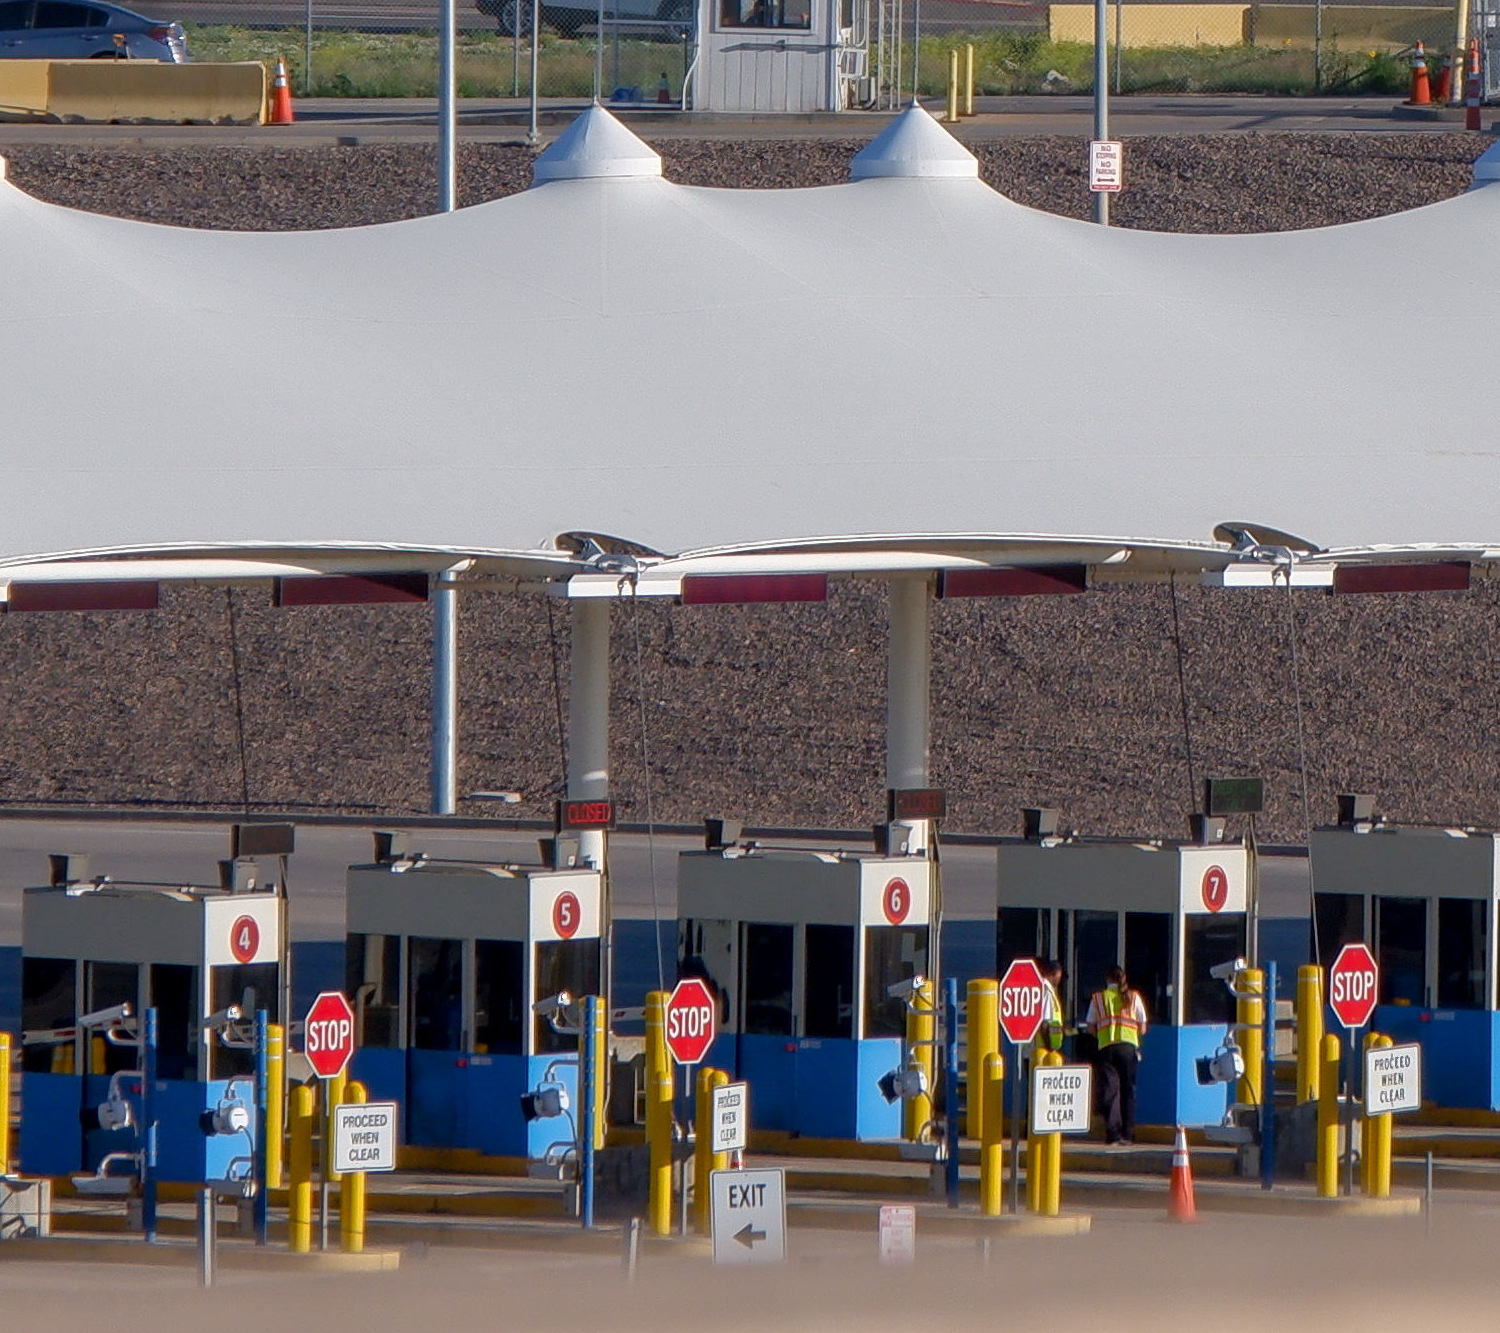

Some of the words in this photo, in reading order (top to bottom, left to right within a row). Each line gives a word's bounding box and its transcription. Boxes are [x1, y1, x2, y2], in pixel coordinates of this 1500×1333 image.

[568, 803, 612, 824] CLOSED
[1210, 876, 1220, 900] 7
[891, 888, 901, 912] 6
[561, 902, 571, 927] 5
[239, 926, 250, 950] 4
[1334, 970, 1374, 1002] STOP
[1002, 986, 1041, 1018] STOP
[308, 1019, 350, 1052] STOP
[668, 1014, 711, 1039] STOP
[1374, 1056, 1411, 1072] PROCEED
[1042, 1075, 1081, 1090] PROCEED
[1381, 1073, 1404, 1086] WHEN
[1049, 1093, 1074, 1106] WHEN
[1379, 1088, 1405, 1104] CLEAR
[342, 1114, 388, 1129] PROCEED
[1046, 1109, 1074, 1123] CLEAR
[350, 1131, 380, 1145] WHEN
[349, 1147, 380, 1161] CLEAR
[728, 1184, 767, 1209] EXIT
